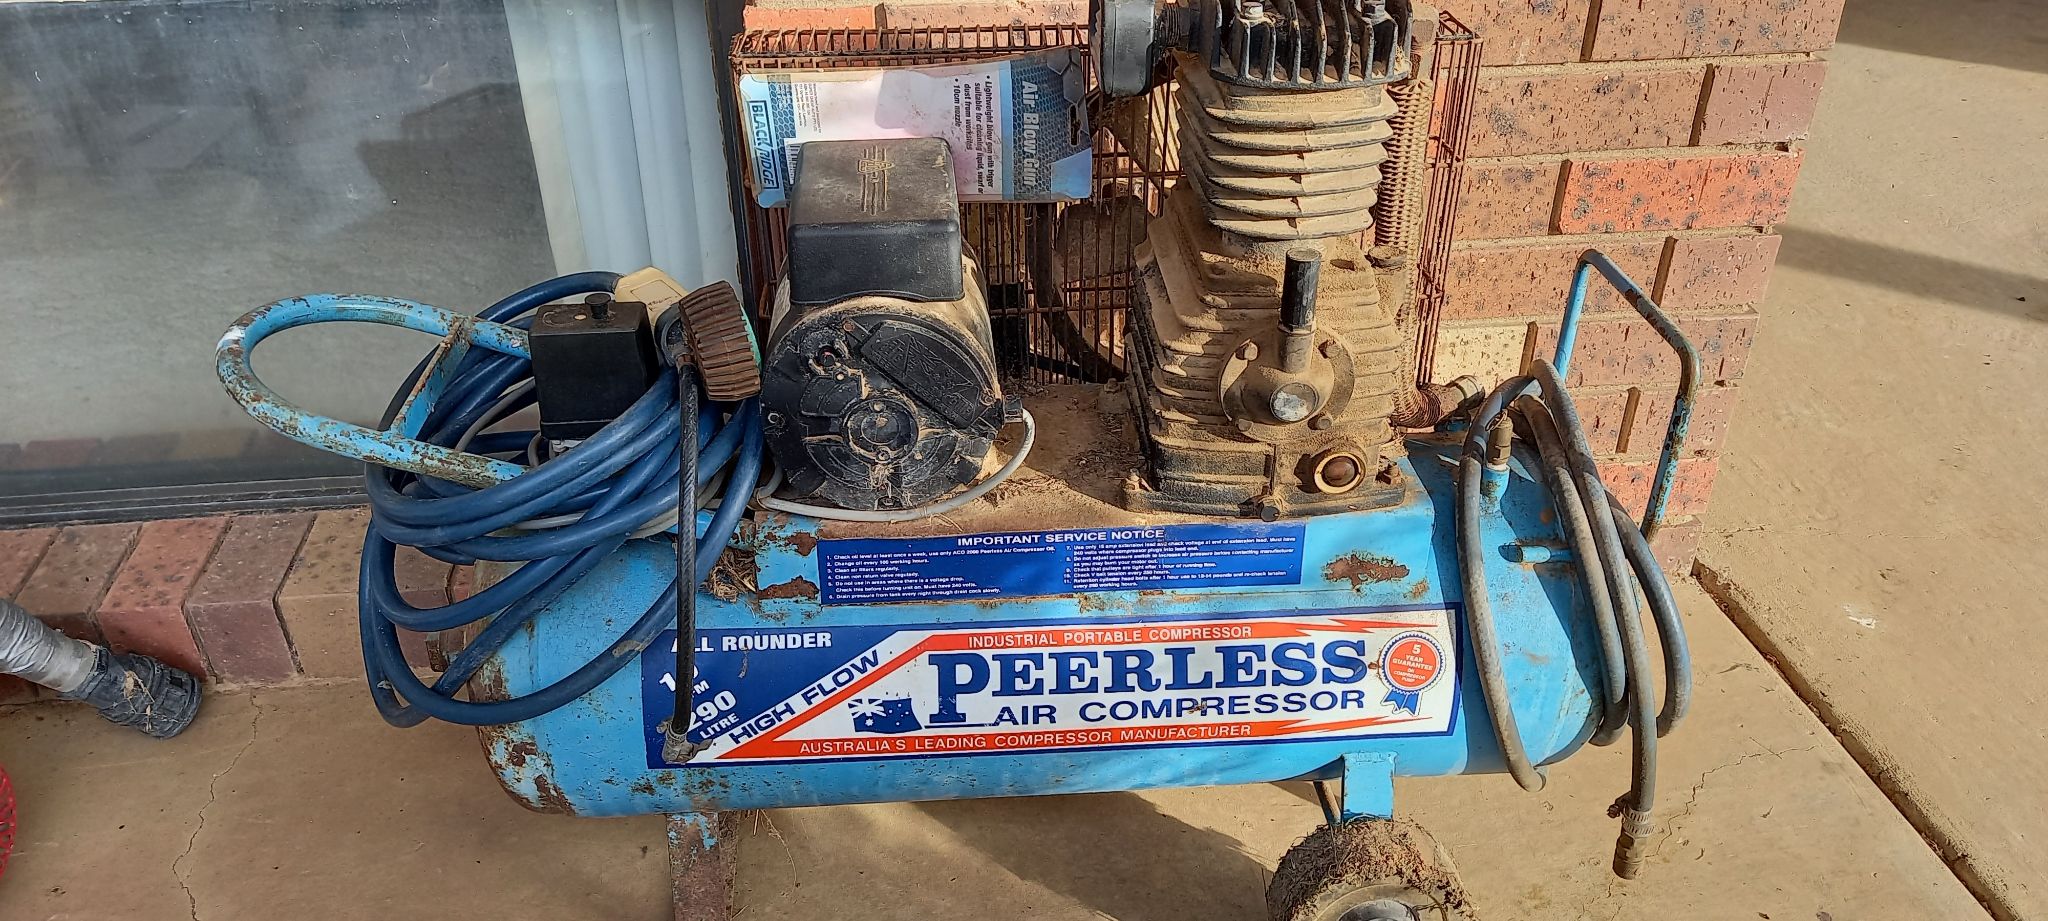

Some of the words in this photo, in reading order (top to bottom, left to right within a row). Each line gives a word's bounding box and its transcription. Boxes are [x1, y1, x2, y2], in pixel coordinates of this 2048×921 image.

[953, 85, 961, 104] 10cm
[964, 83, 972, 102] dust
[974, 82, 982, 112] suitable
[984, 81, 993, 123] Lightweight
[1022, 80, 1039, 108] Air
[954, 105, 962, 127] nozzle
[964, 102, 972, 118] from
[975, 112, 983, 122] for
[965, 119, 973, 151] worksites
[975, 123, 984, 151] cleaning
[986, 124, 994, 141] blow
[1023, 113, 1040, 153] Blow
[984, 142, 993, 154] gun
[975, 152, 984, 171] liquid,
[977, 171, 985, 187] swarf
[986, 169, 994, 188] trigger
[1023, 158, 1040, 186] Gun
[958, 535, 1041, 546] IMPORTANT
[1045, 532, 1107, 542] SERVICE
[1111, 530, 1165, 540] NOTICE
[722, 632, 832, 651] ROUNDER
[968, 632, 1058, 648] INDUSTRIAL
[1064, 629, 1142, 644] PORTABLE
[1149, 626, 1252, 641] COMPRESSOR
[1405, 654, 1424, 663] YEAR
[1412, 644, 1422, 655] 5
[1392, 658, 1433, 671] GUARANTEE
[928, 640, 1368, 724] PEERLESS
[1393, 670, 1426, 680] COMPRESSOR
[729, 702, 797, 744] HIGH
[801, 650, 879, 706] FLOW
[993, 704, 1057, 726] AIR
[1078, 689, 1365, 723] COMPRESSOR
[700, 713, 739, 739] LITRE
[800, 739, 906, 754] AUSTRALIA'S
[915, 736, 986, 750] LEADING
[995, 731, 1112, 747] COMPRESSOR
[1120, 725, 1251, 742] MANUFACTURER
